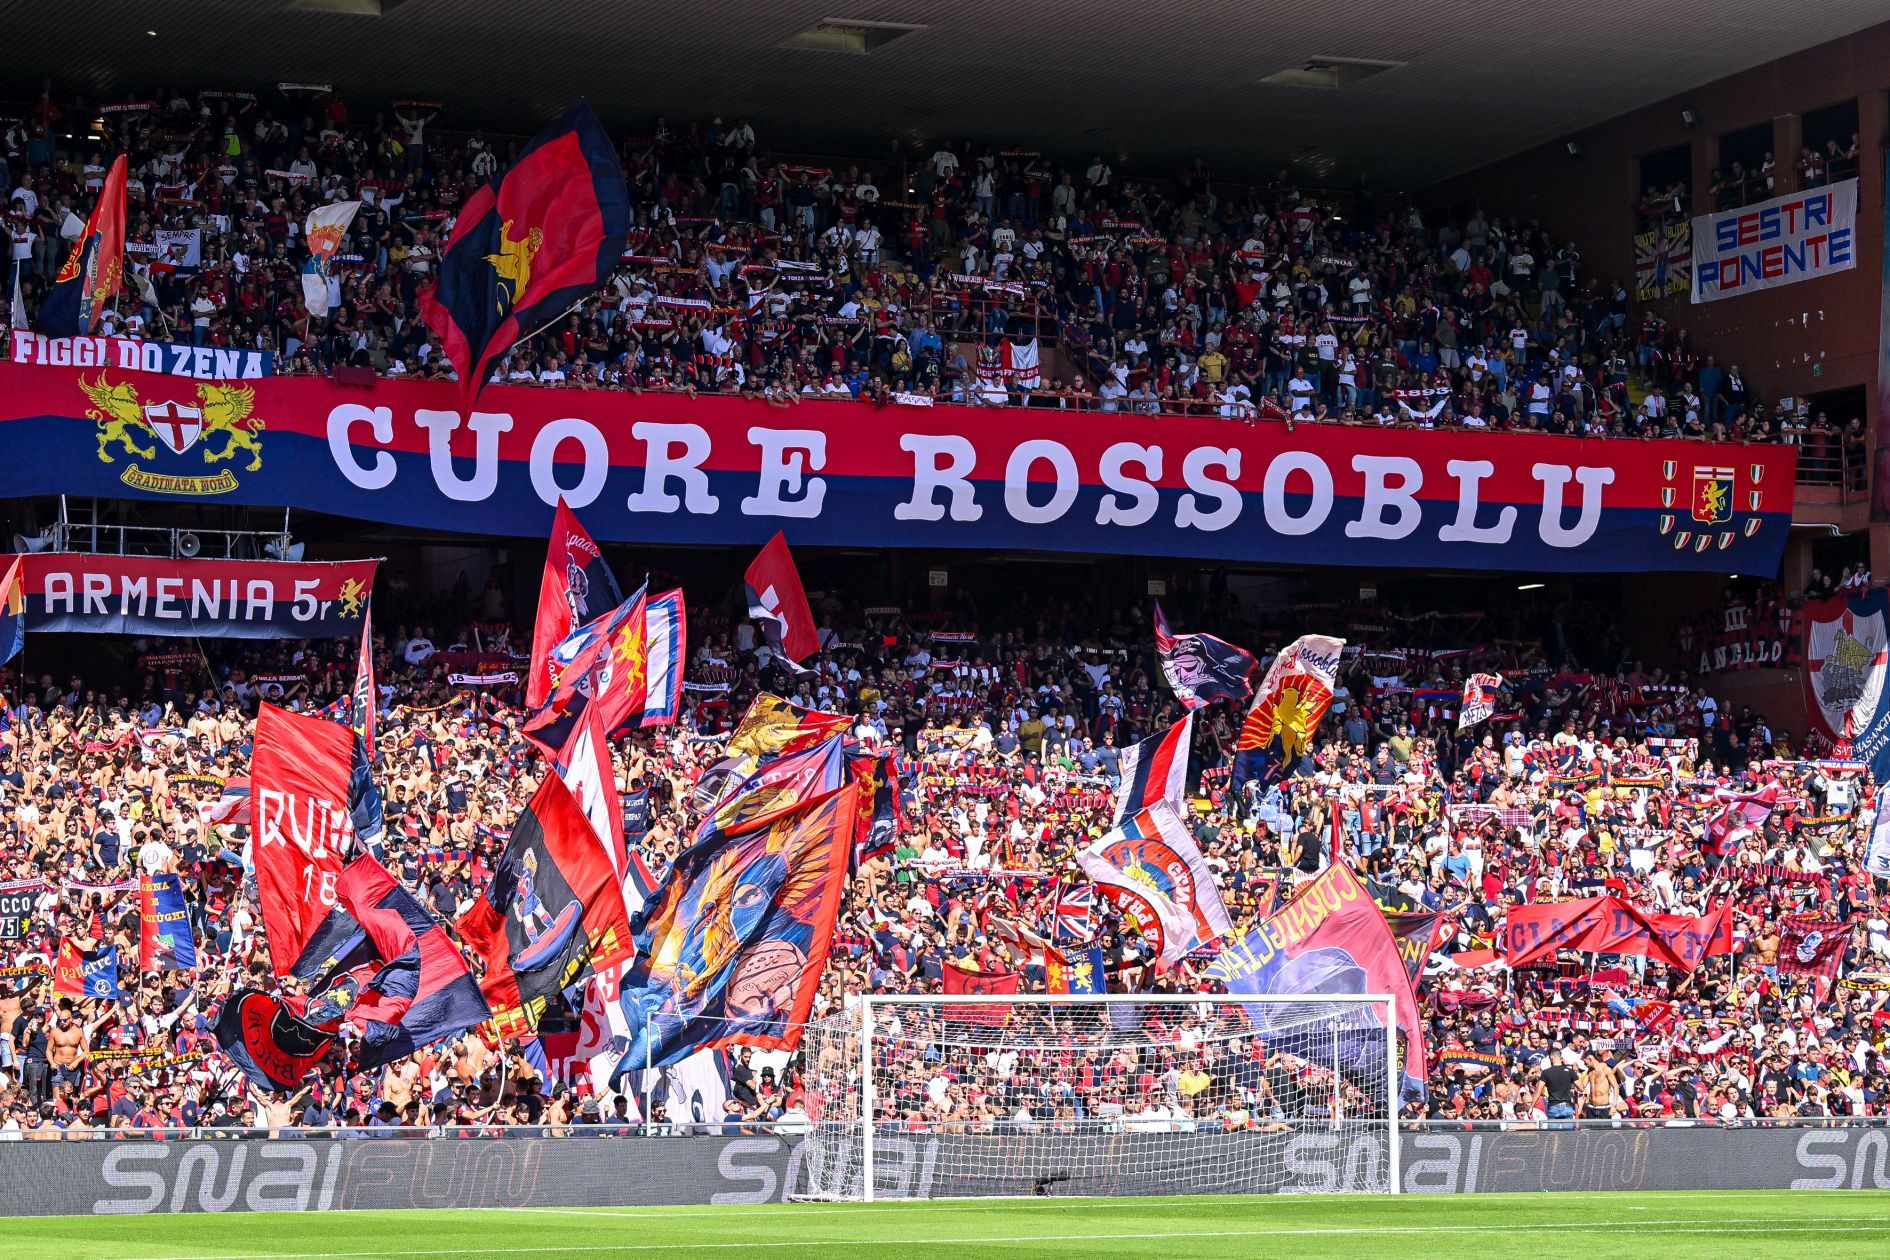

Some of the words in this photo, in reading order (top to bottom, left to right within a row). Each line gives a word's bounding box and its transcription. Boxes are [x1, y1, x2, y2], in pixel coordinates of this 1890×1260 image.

[160, 230, 195, 242] SEMPRE
[1717, 193, 1833, 253] SESTRI
[1697, 228, 1851, 295] PONENTE
[14, 330, 110, 367] FIGGI
[118, 341, 163, 374] DO
[170, 345, 264, 381] ZENA
[126, 472, 199, 493] GRADINATA
[200, 473, 233, 491] NORD
[326, 402, 827, 519] CUORE
[894, 433, 1615, 549] ROSSOBLU
[44, 571, 275, 621] ARMENIA
[1698, 640, 1782, 674] ANELLO
[150, 898, 160, 906] E
[61, 957, 113, 983] Parterre
